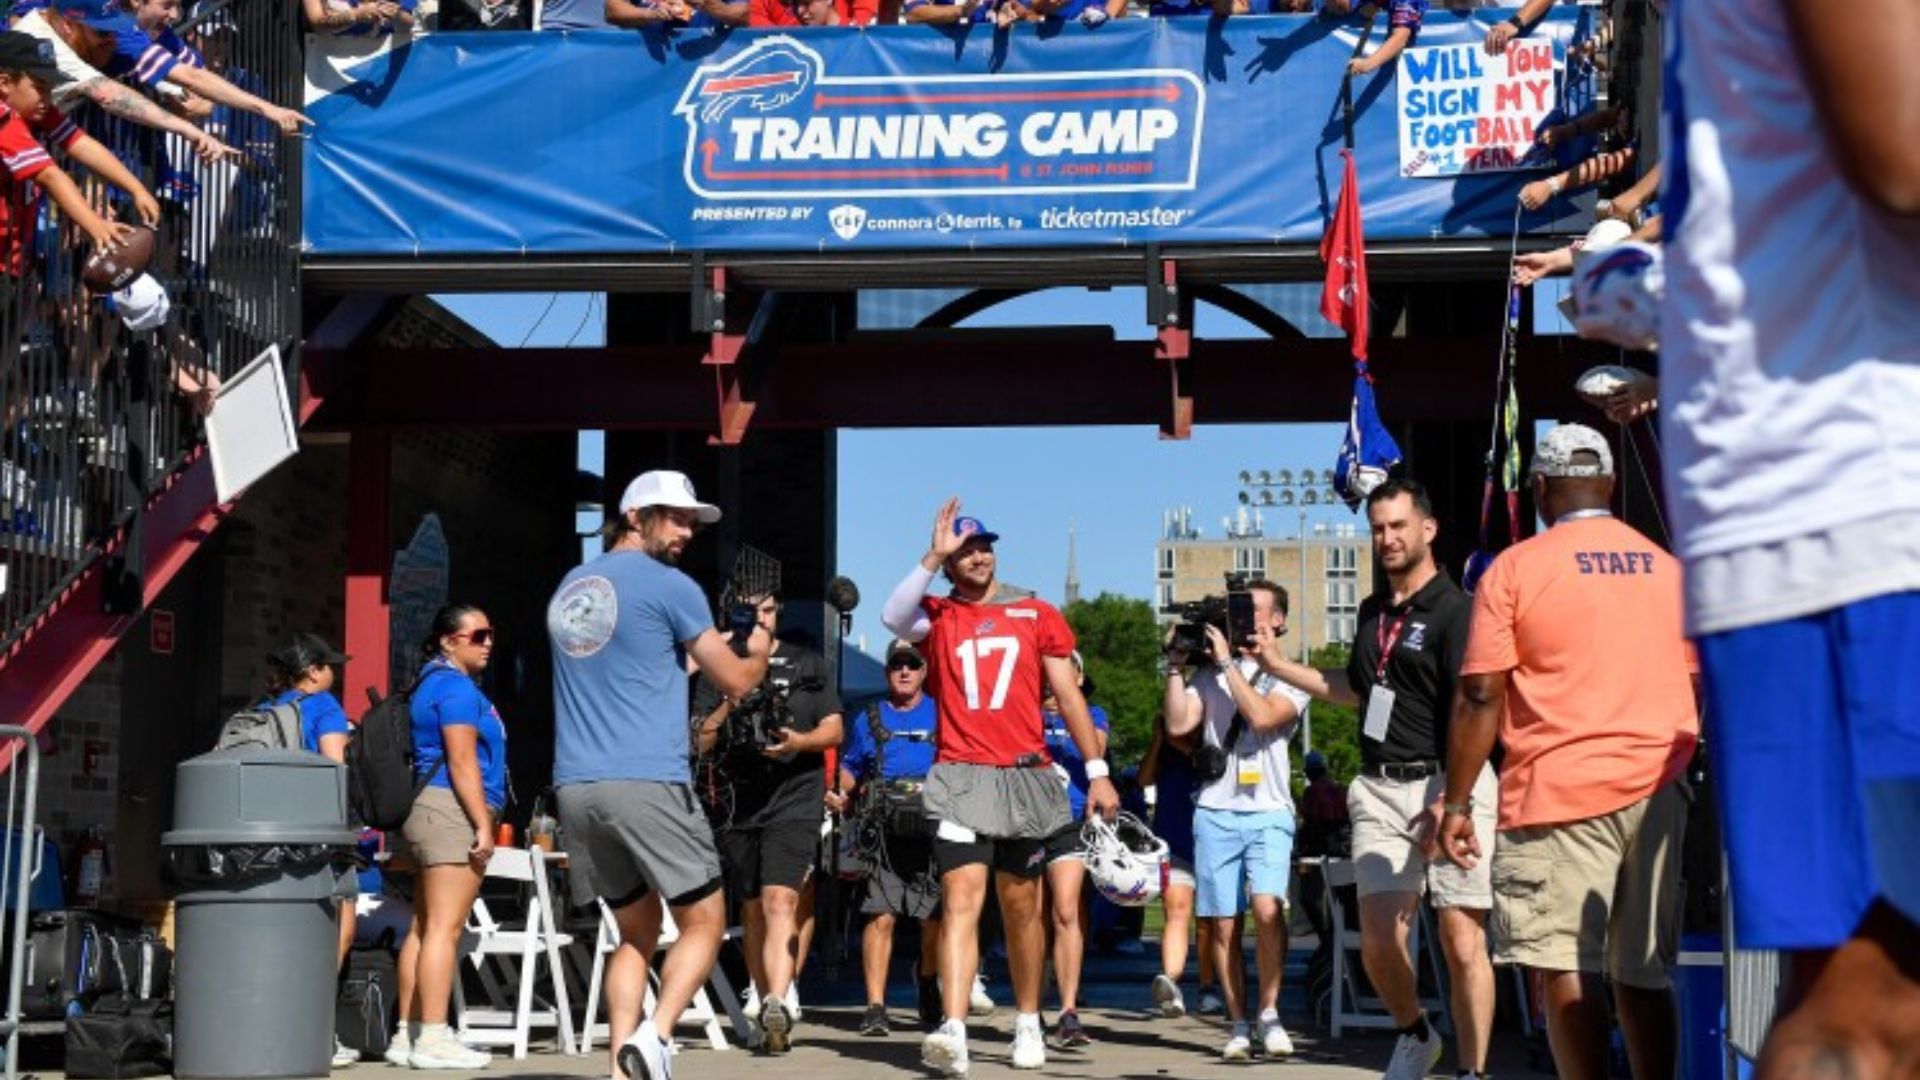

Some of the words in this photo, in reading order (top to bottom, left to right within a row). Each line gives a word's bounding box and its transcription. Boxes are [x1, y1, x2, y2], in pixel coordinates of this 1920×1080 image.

[1404, 48, 1483, 84] WILL
[1505, 40, 1552, 77] YOU
[1404, 86, 1480, 118] SIGN
[1495, 79, 1551, 111] MY
[730, 112, 1008, 162] TRAINING
[1019, 108, 1179, 158] CAMP
[1409, 117, 1536, 148] FOOTBALL
[691, 207, 788, 221] PRESENTED
[790, 206, 814, 219] BY
[867, 218, 933, 231] connors
[1039, 206, 1187, 229] ticketmaster
[1575, 551, 1654, 574] STAFF
[955, 636, 1020, 711] 17
